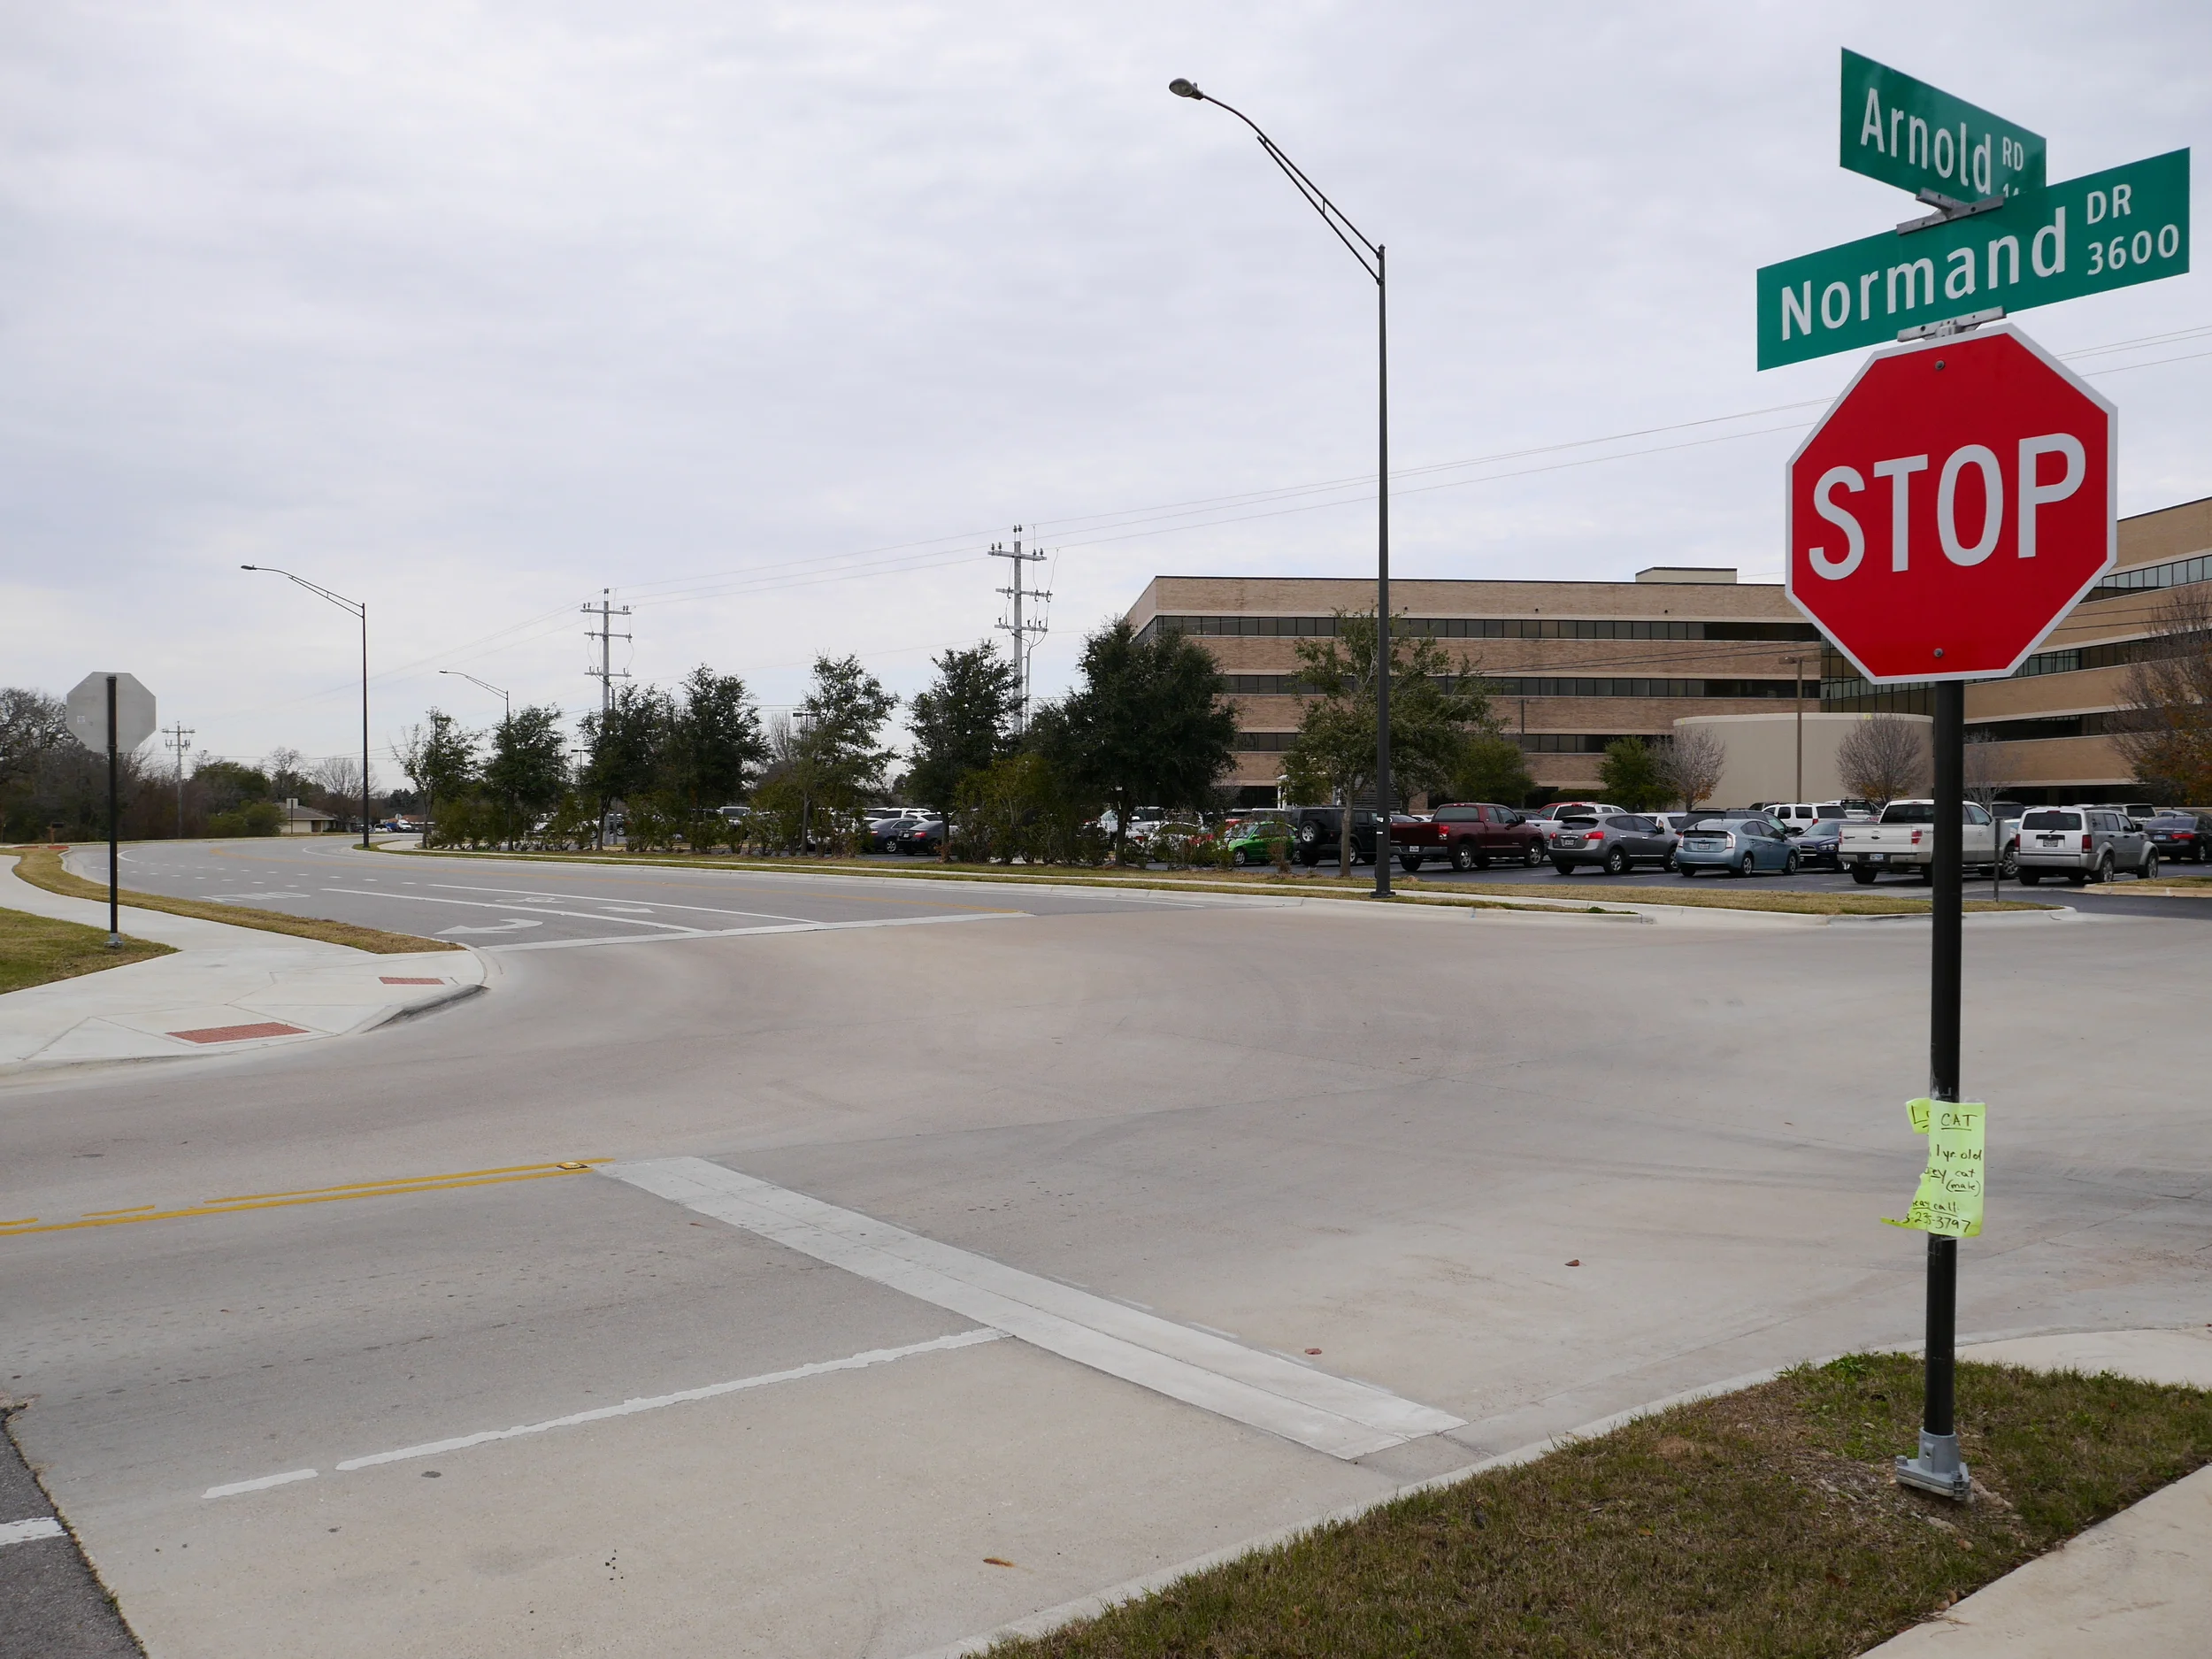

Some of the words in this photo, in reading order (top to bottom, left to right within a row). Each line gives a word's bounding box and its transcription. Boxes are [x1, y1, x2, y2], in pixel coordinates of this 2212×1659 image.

[1860, 87, 1993, 196] Arnold
[2002, 135, 2024, 172] RD
[1780, 205, 2067, 342] Normand
[2086, 183, 2132, 226] DR
[2086, 223, 2180, 276] 3600
[1809, 433, 2086, 580] STOP
[1941, 1112, 1978, 1126] CAT
[1955, 1168, 1976, 1178] cat
[1960, 1148, 1982, 1161] old
